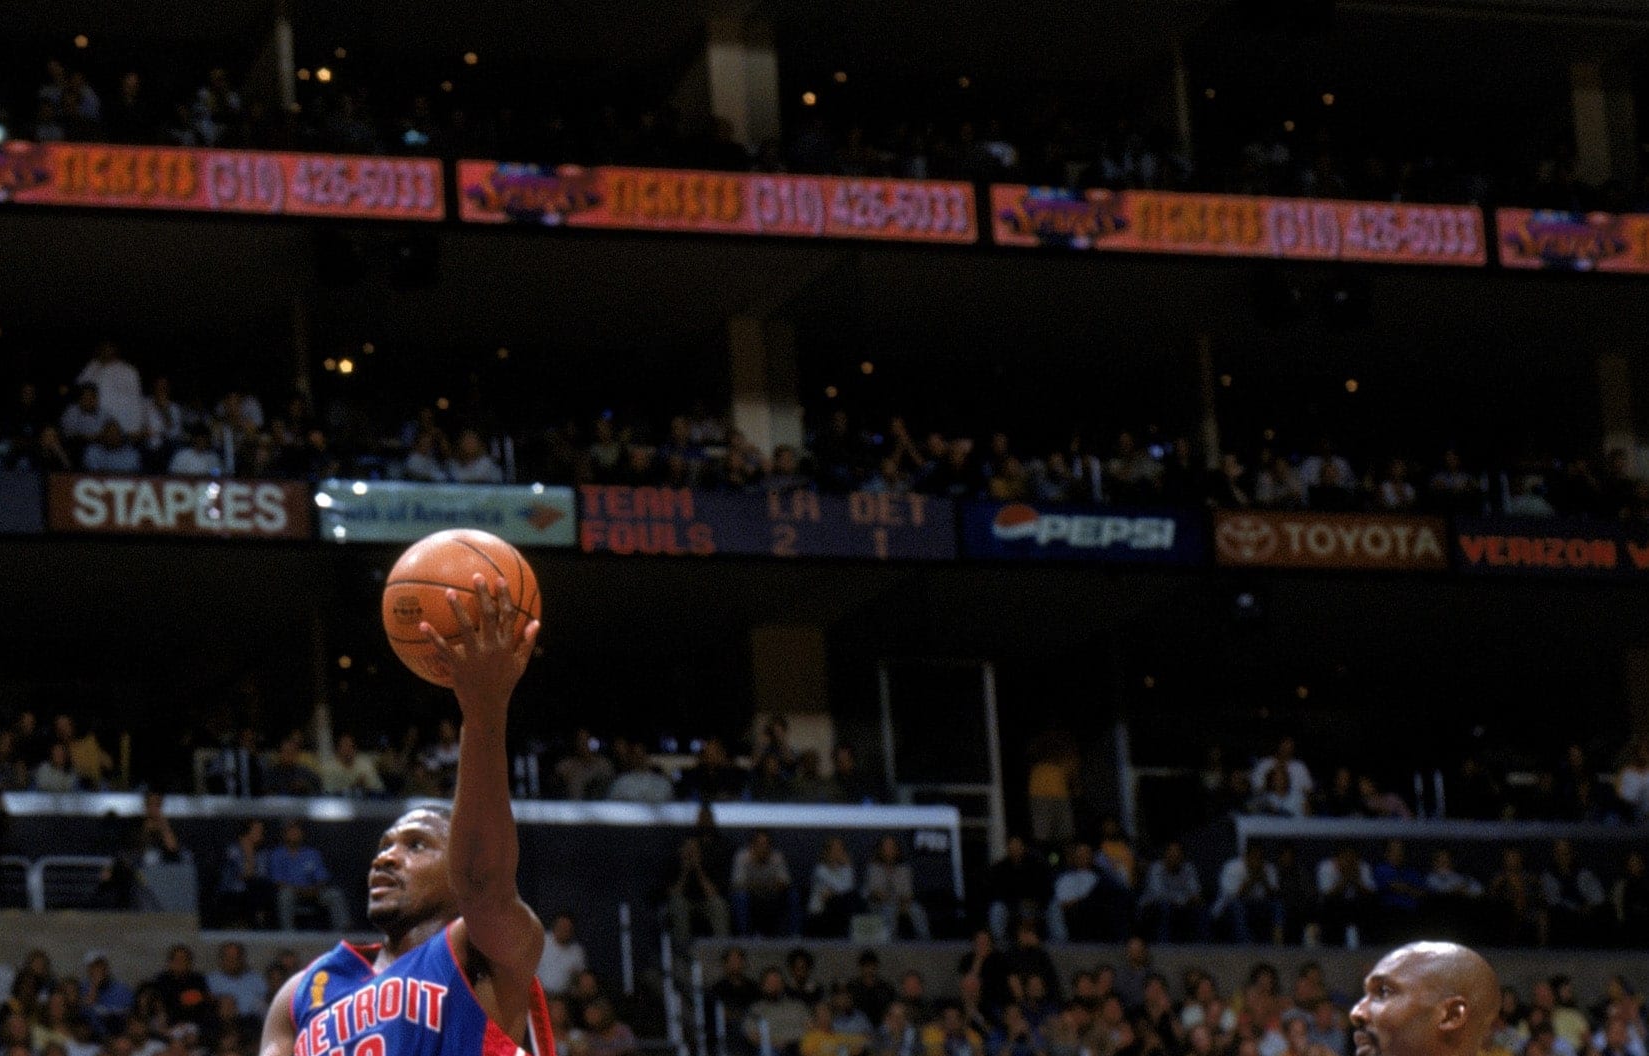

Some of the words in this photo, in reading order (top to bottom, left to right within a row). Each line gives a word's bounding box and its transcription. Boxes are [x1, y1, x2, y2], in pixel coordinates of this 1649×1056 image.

[71, 476, 289, 532] STAPLES
[578, 484, 695, 521] TEAM
[766, 488, 822, 523] LA
[848, 490, 928, 528] DET
[579, 519, 717, 556] FOULS
[771, 523, 798, 558] 2
[872, 526, 889, 561] 1
[1035, 513, 1177, 551] PEPSI
[1284, 523, 1445, 558] TOYOTA
[1457, 534, 1619, 569] VERIZON
